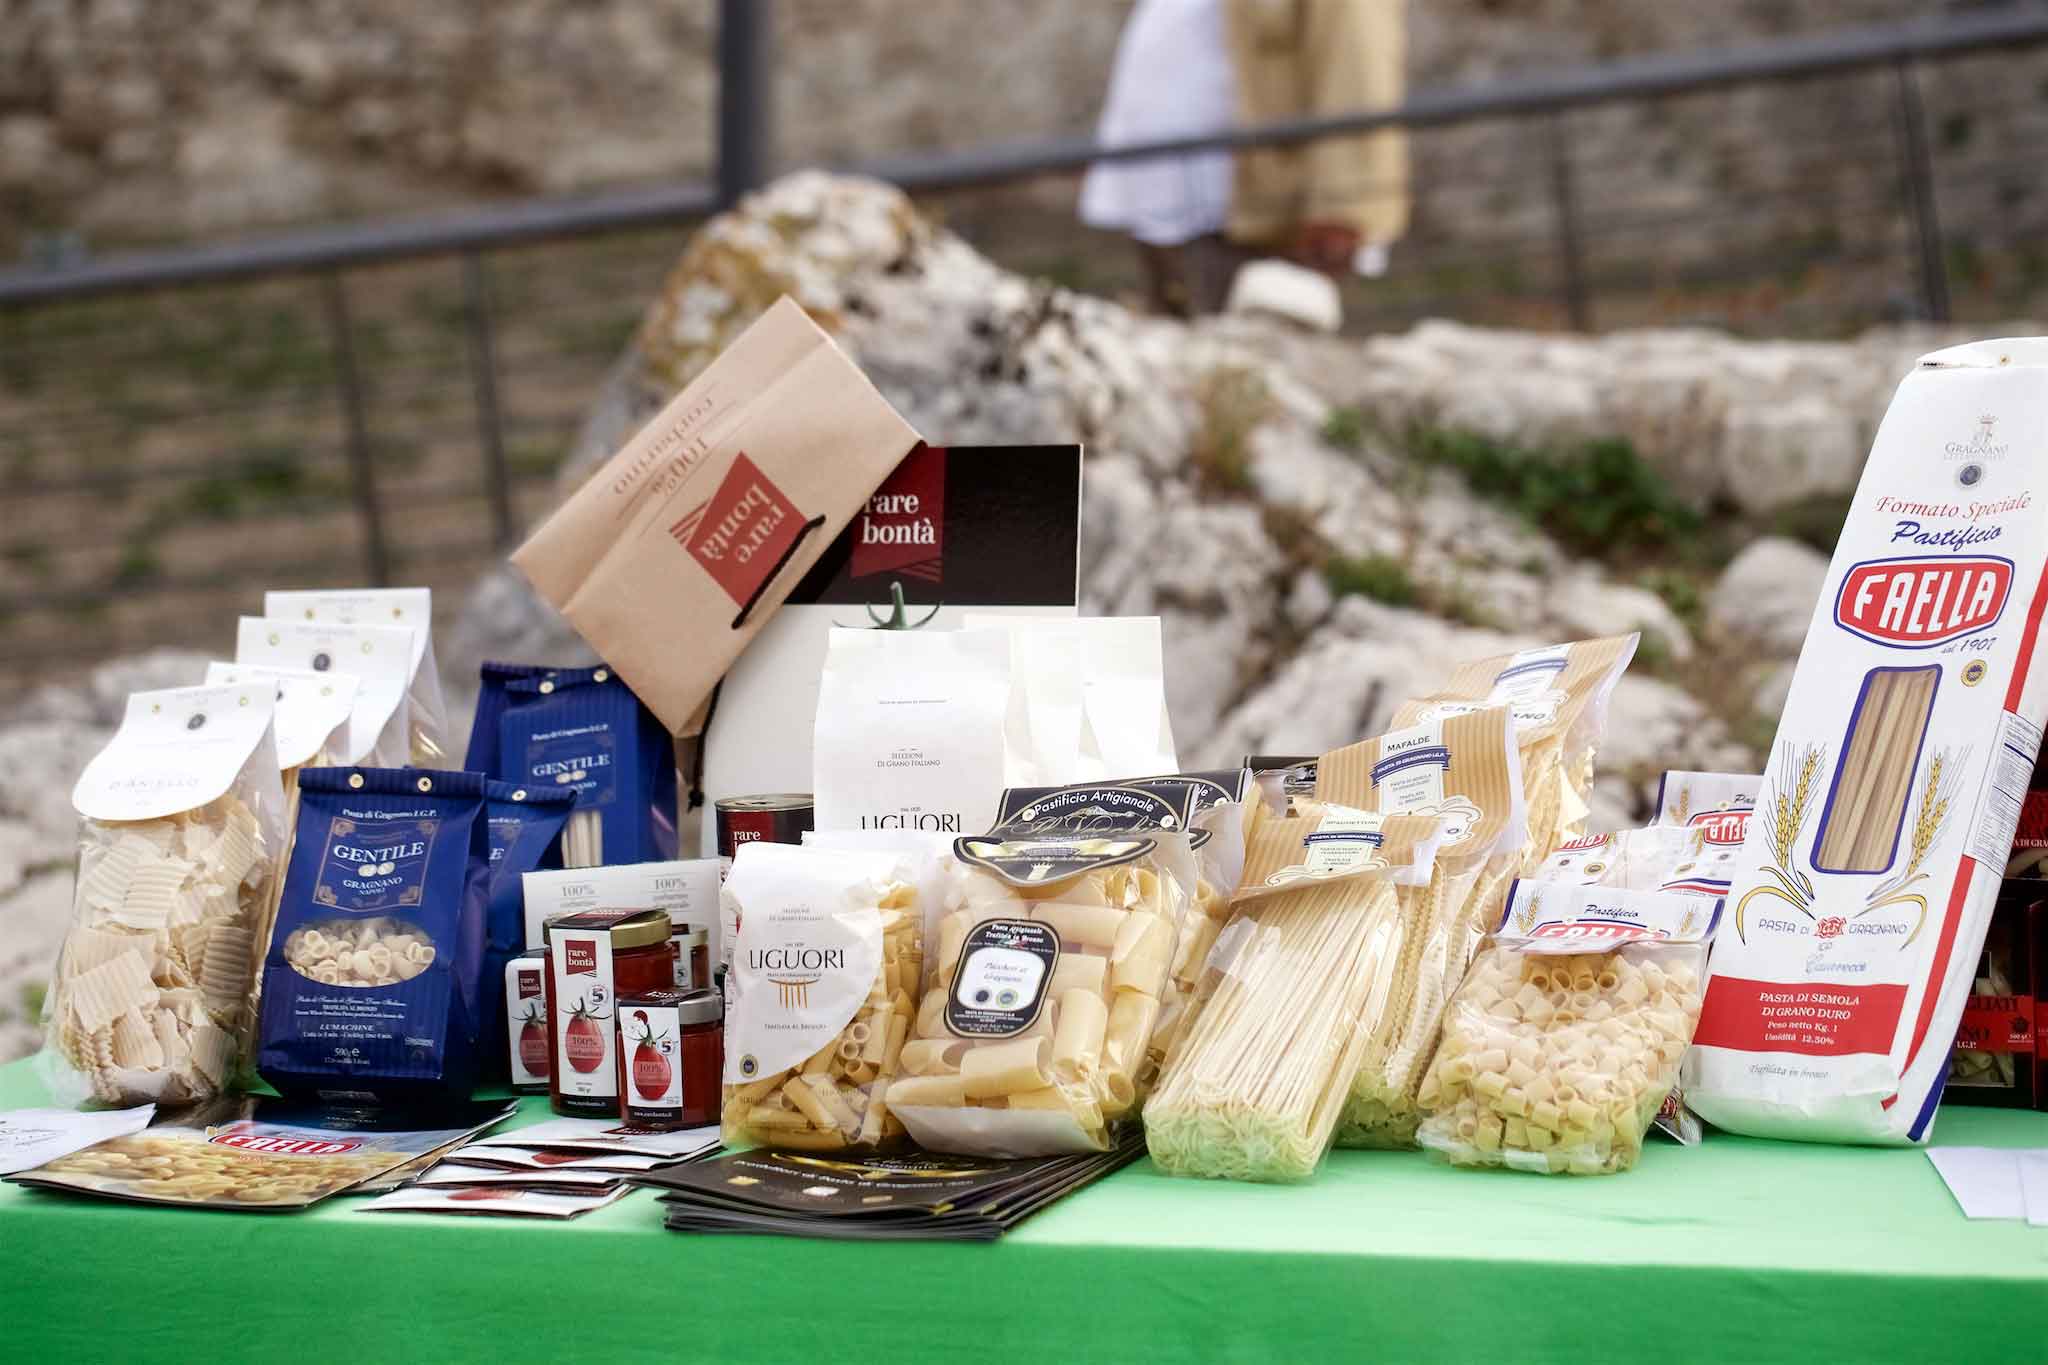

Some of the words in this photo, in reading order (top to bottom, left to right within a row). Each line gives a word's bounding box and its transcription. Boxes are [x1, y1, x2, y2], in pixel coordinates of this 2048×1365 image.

[650, 436, 708, 496] 100%
[1876, 496, 1959, 518] Formato
[1962, 491, 2031, 522] Speciale
[700, 482, 771, 561] bontà
[735, 503, 786, 564] rare
[862, 516, 937, 544] bontà
[1891, 521, 2003, 552] Pastificio
[1853, 569, 1998, 634] FAELLA
[1960, 638, 1996, 652] 1907
[1387, 736, 1431, 752] MAFALDE
[532, 754, 610, 777] GENTILE
[1034, 792, 1088, 816] Pastificio
[1091, 789, 1155, 812] Artigianale
[733, 830, 761, 841] rare
[333, 842, 425, 862] GENTILE
[343, 876, 403, 889] GRAGNANO
[655, 878, 687, 890] 100%
[359, 888, 386, 896] NAPOLI
[562, 885, 595, 897] 100%
[1584, 903, 1639, 918] Pastificio
[1759, 918, 1796, 933] PASTA
[1800, 926, 1809, 934] DI
[1849, 923, 1908, 935] GRAGNANO
[568, 949, 588, 958] rare
[749, 949, 844, 970] LIGUORI
[568, 957, 595, 967] bontà
[592, 989, 604, 1003] 5
[1760, 992, 1794, 1003] PASTA
[1796, 992, 1809, 1003] DI
[1811, 994, 1860, 1006] SEMOLA
[1762, 1007, 1774, 1016] DI
[1776, 1007, 1816, 1017] GRANO
[1817, 1008, 1851, 1020] DURO
[1768, 1021, 1788, 1029] Peso
[1789, 1021, 1812, 1030] netto
[1814, 1022, 1830, 1032] Kg.
[1833, 1024, 1838, 1033] 1
[573, 1036, 598, 1046] 100%
[1802, 1034, 1834, 1045] 12.50%
[661, 1040, 671, 1054] 5
[639, 1063, 664, 1074] 100%
[225, 1135, 346, 1154] FAELLA
